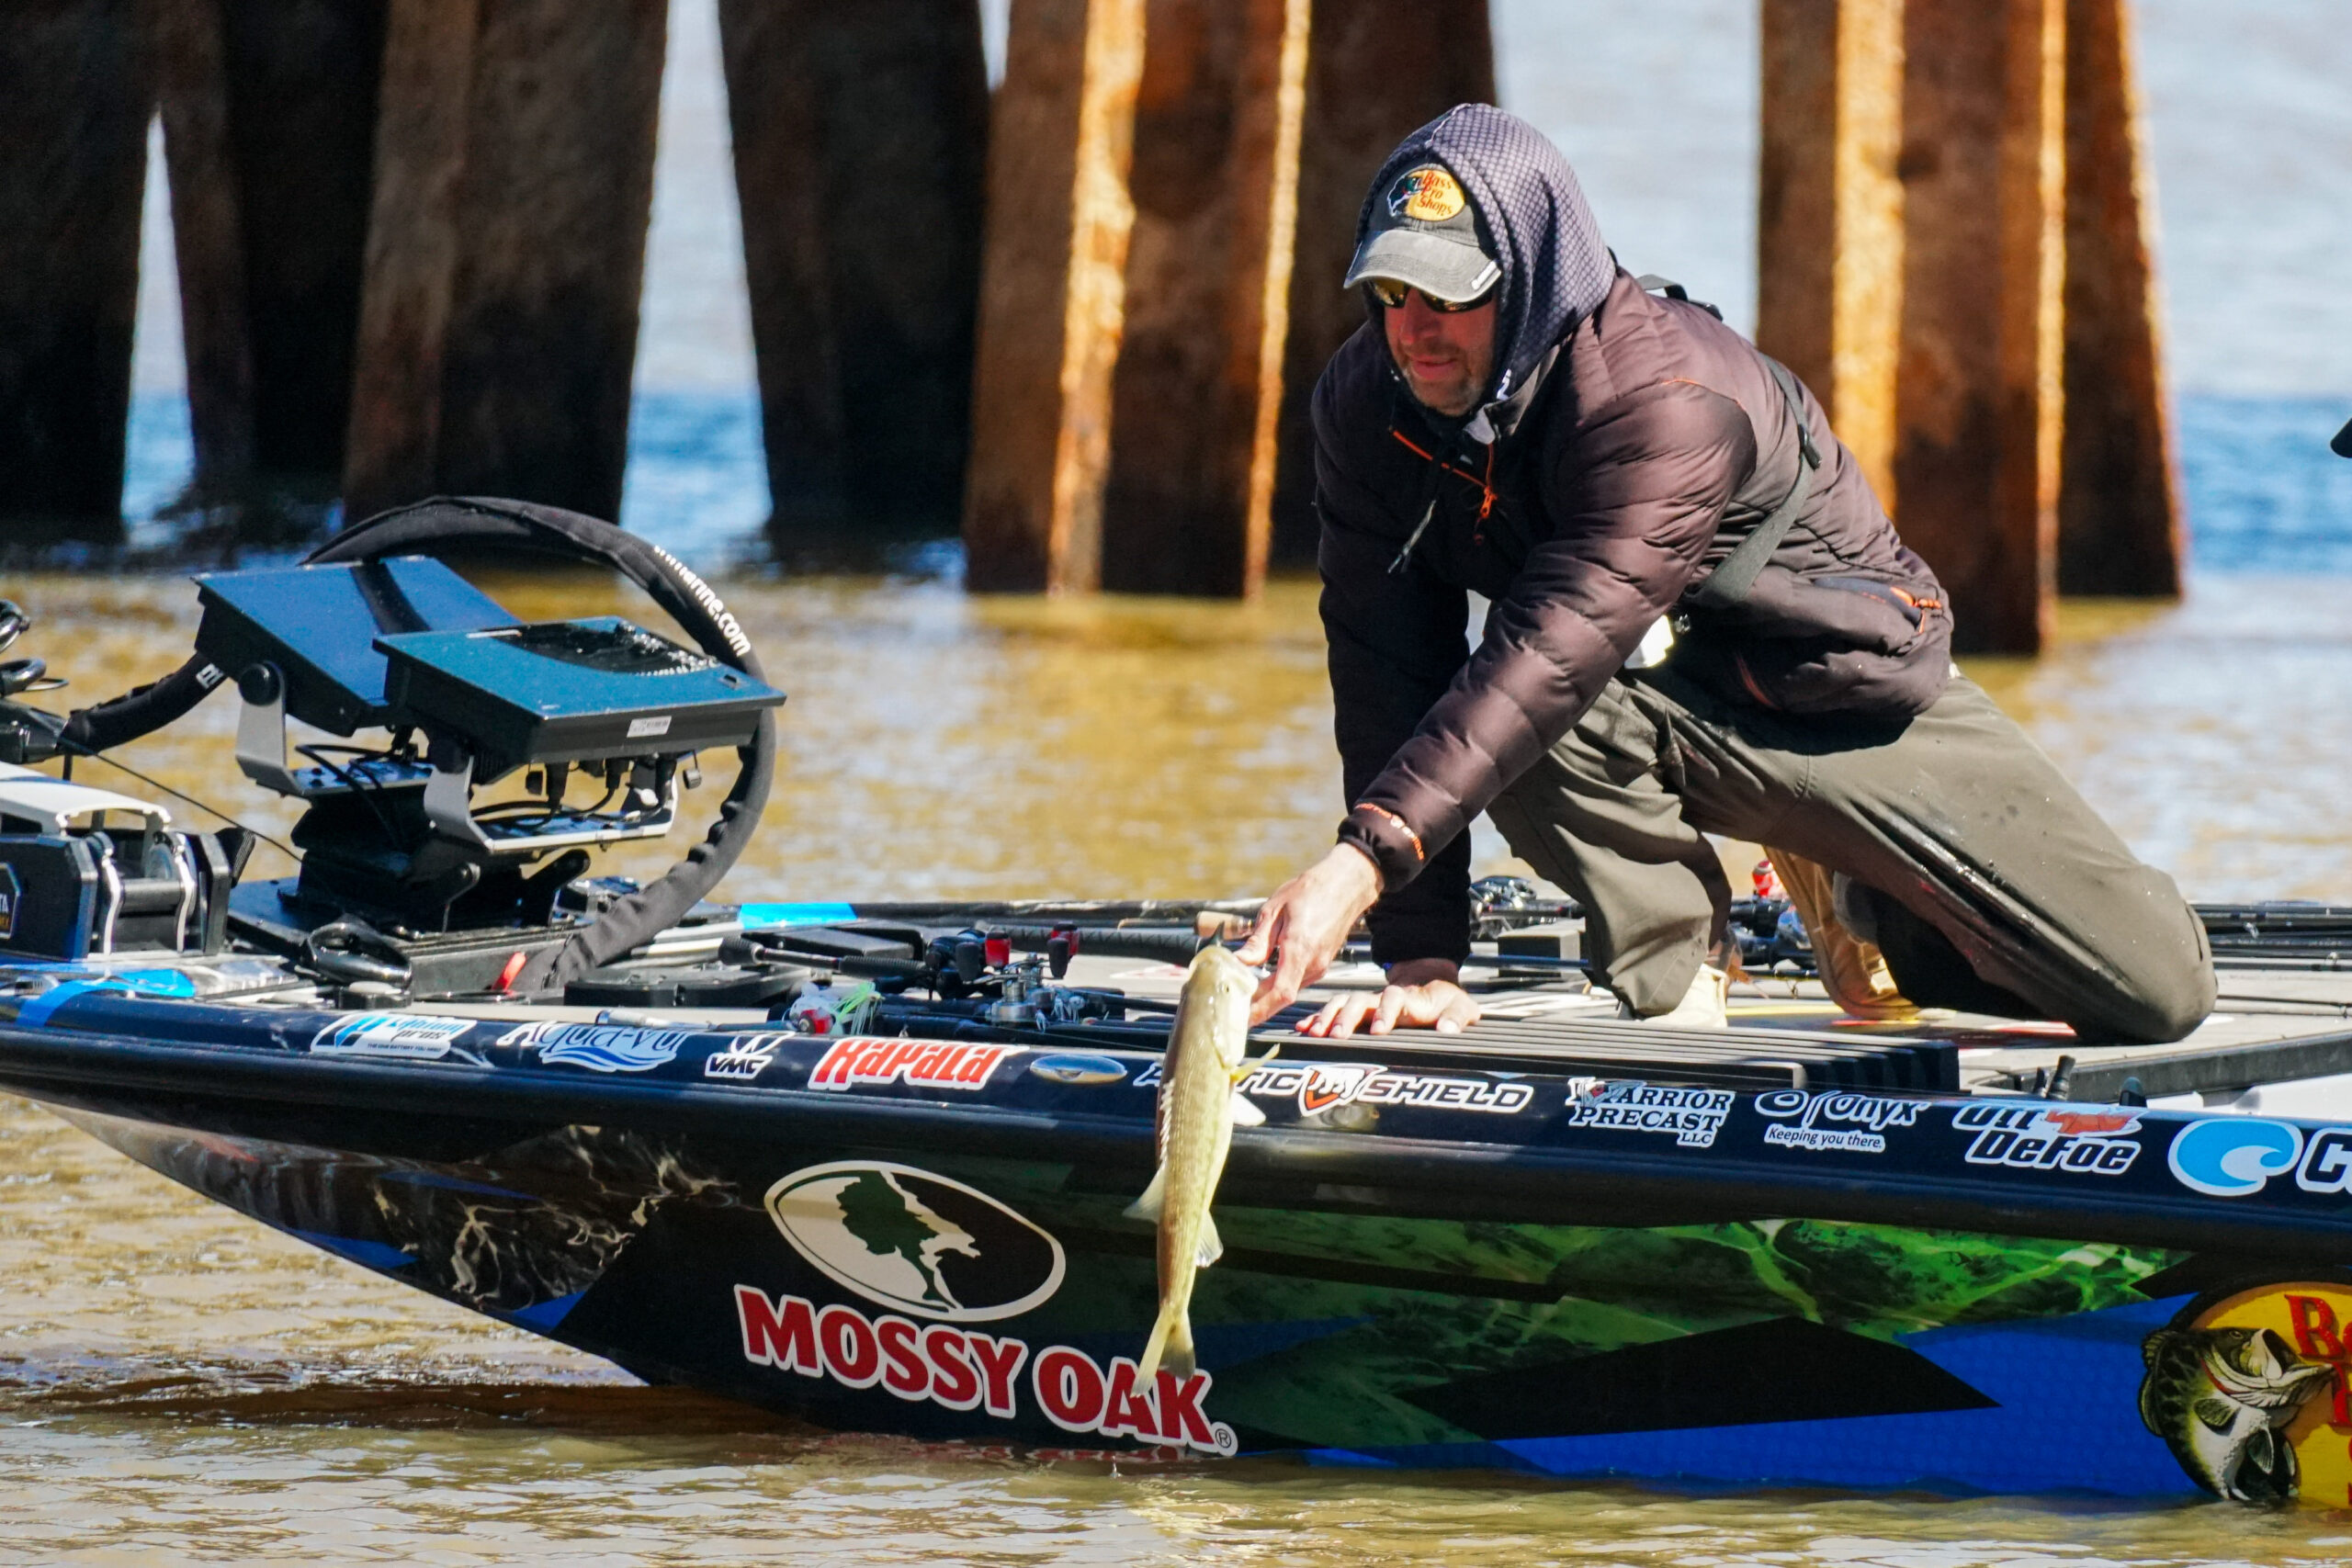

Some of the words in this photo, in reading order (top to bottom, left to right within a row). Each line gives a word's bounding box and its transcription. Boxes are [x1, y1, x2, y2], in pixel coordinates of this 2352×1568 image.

[1422, 171, 1452, 189] Bass
[1420, 185, 1443, 198] Pro
[1417, 197, 1453, 216] Shops
[708, 1056, 764, 1074] VMC
[1364, 1076, 1530, 1111] SHIELD
[1572, 1106, 1724, 1132] PRECAST
[1680, 1133, 1713, 1145] LLC
[1769, 1127, 1816, 1145] Keeping
[1820, 1134, 1844, 1146] you
[1847, 1134, 1883, 1149] there.
[1971, 1130, 2137, 1169] DeFoe
[738, 1288, 1023, 1411] MOSSY
[1037, 1350, 1215, 1445] OAK
